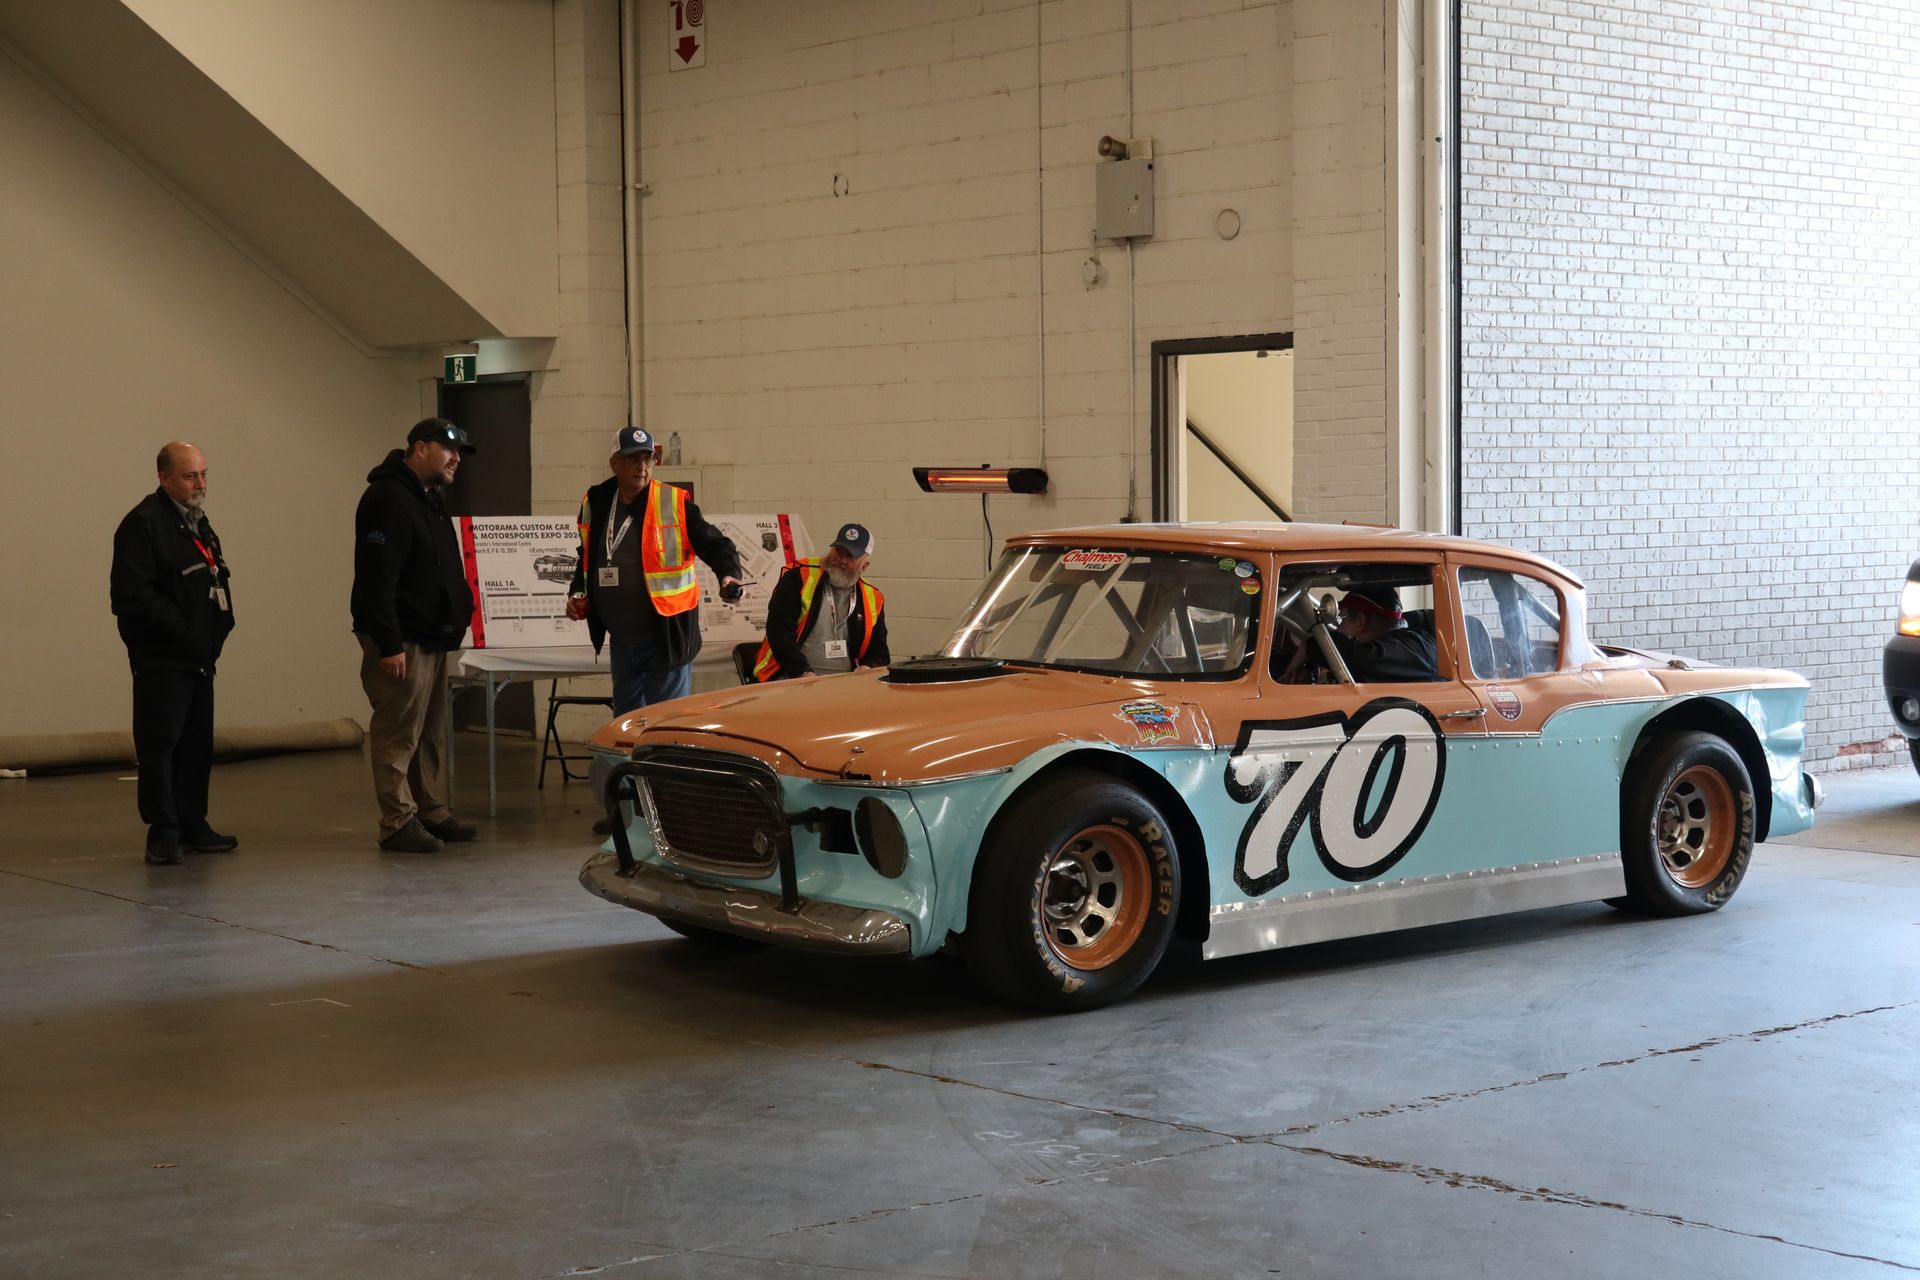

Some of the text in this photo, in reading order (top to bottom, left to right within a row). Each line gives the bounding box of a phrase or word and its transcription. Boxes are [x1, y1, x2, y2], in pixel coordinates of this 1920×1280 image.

[472, 524, 518, 532] MOTORAMA
[555, 523, 570, 531] CAR
[1062, 550, 1126, 565] Chalmers
[1225, 698, 1446, 896] 70
[1704, 790, 1754, 905] AMERICAN
[1138, 817, 1174, 917] RACER
[1031, 852, 1086, 993] AMERICAN
